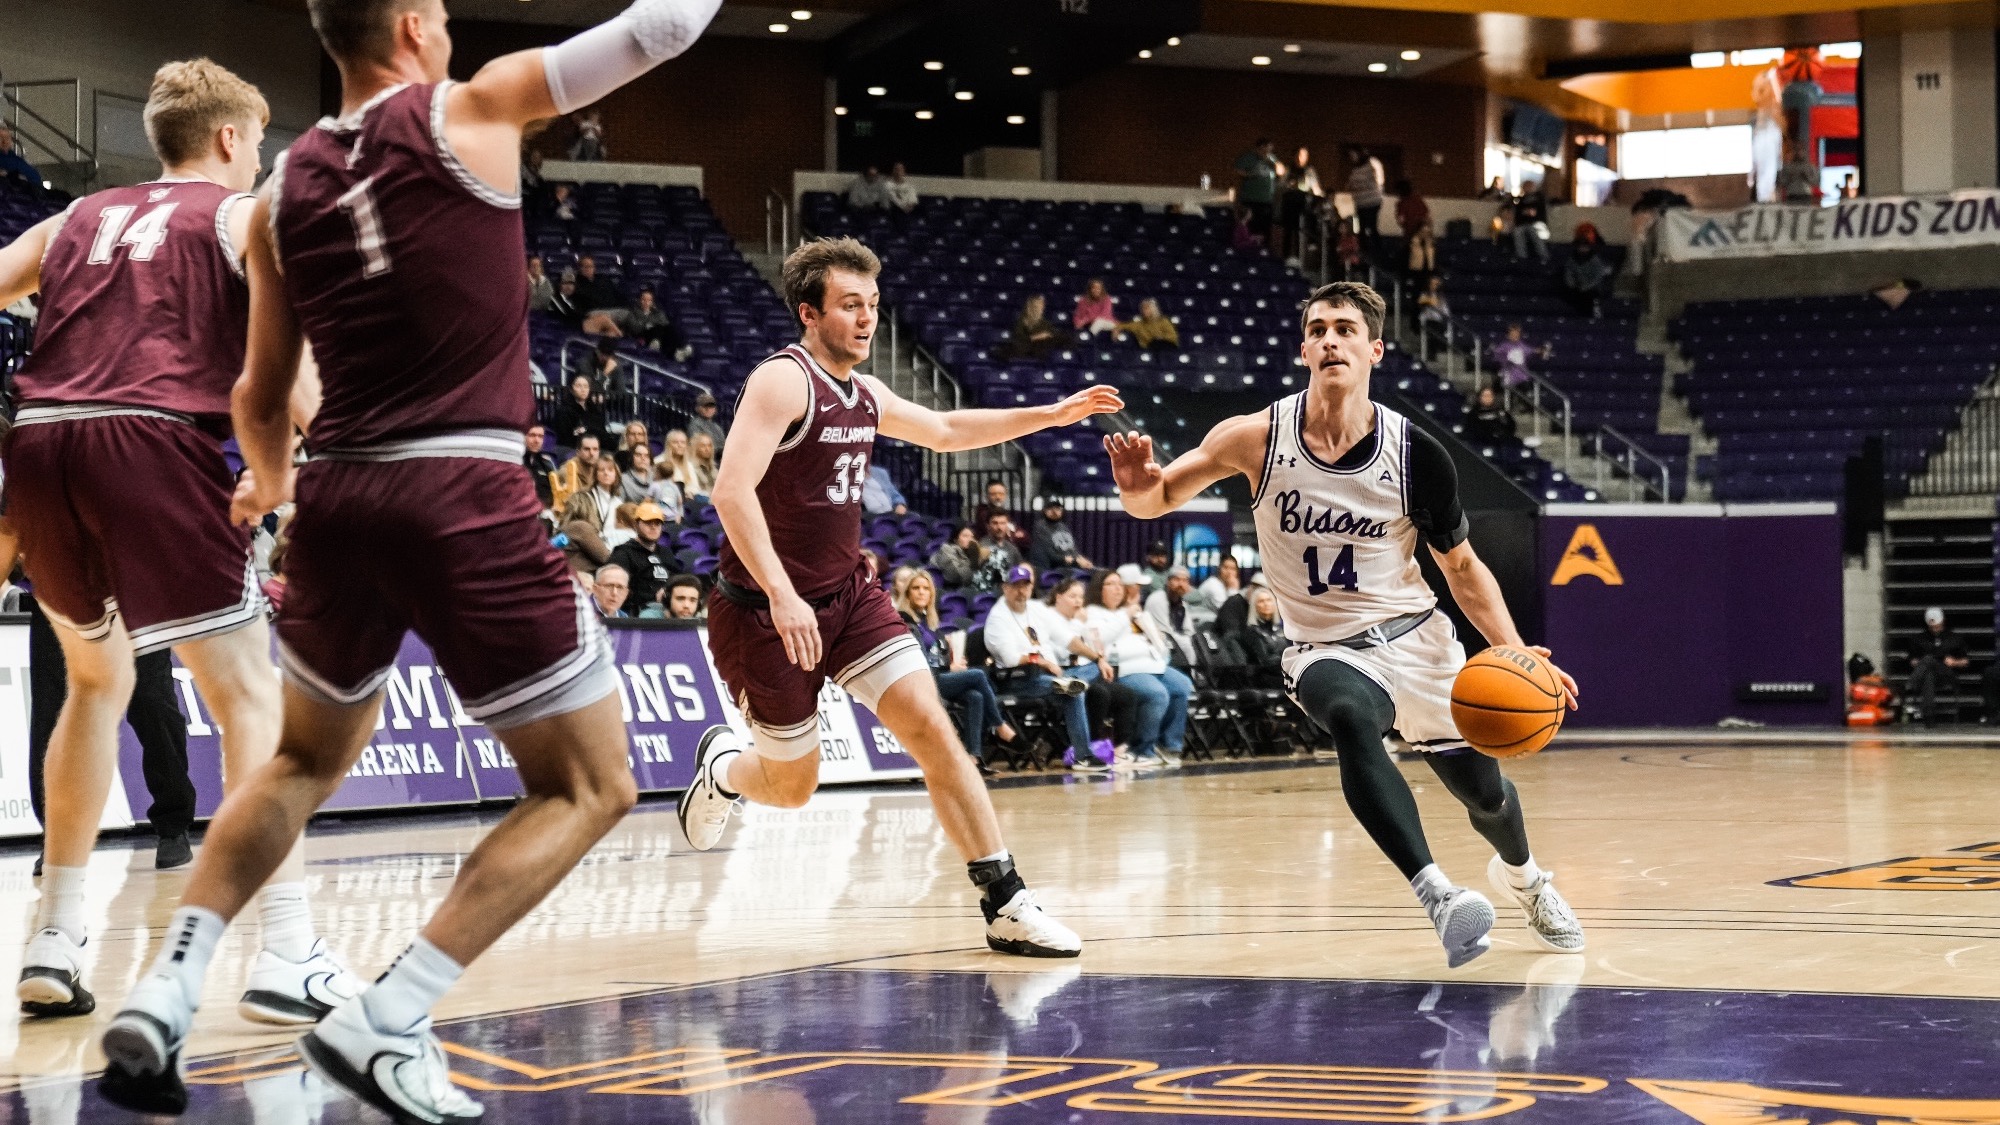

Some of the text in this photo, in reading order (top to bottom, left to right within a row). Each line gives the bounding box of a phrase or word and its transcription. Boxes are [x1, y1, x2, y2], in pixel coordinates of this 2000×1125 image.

[86, 202, 181, 265] 14
[337, 175, 393, 280] 1
[1732, 206, 1826, 243] ELITE
[1832, 199, 1921, 240] KIDS
[826, 451, 867, 505] 33
[1274, 489, 1391, 538] Bisons
[1303, 544, 1358, 596] 14
[633, 734, 673, 763] TN
